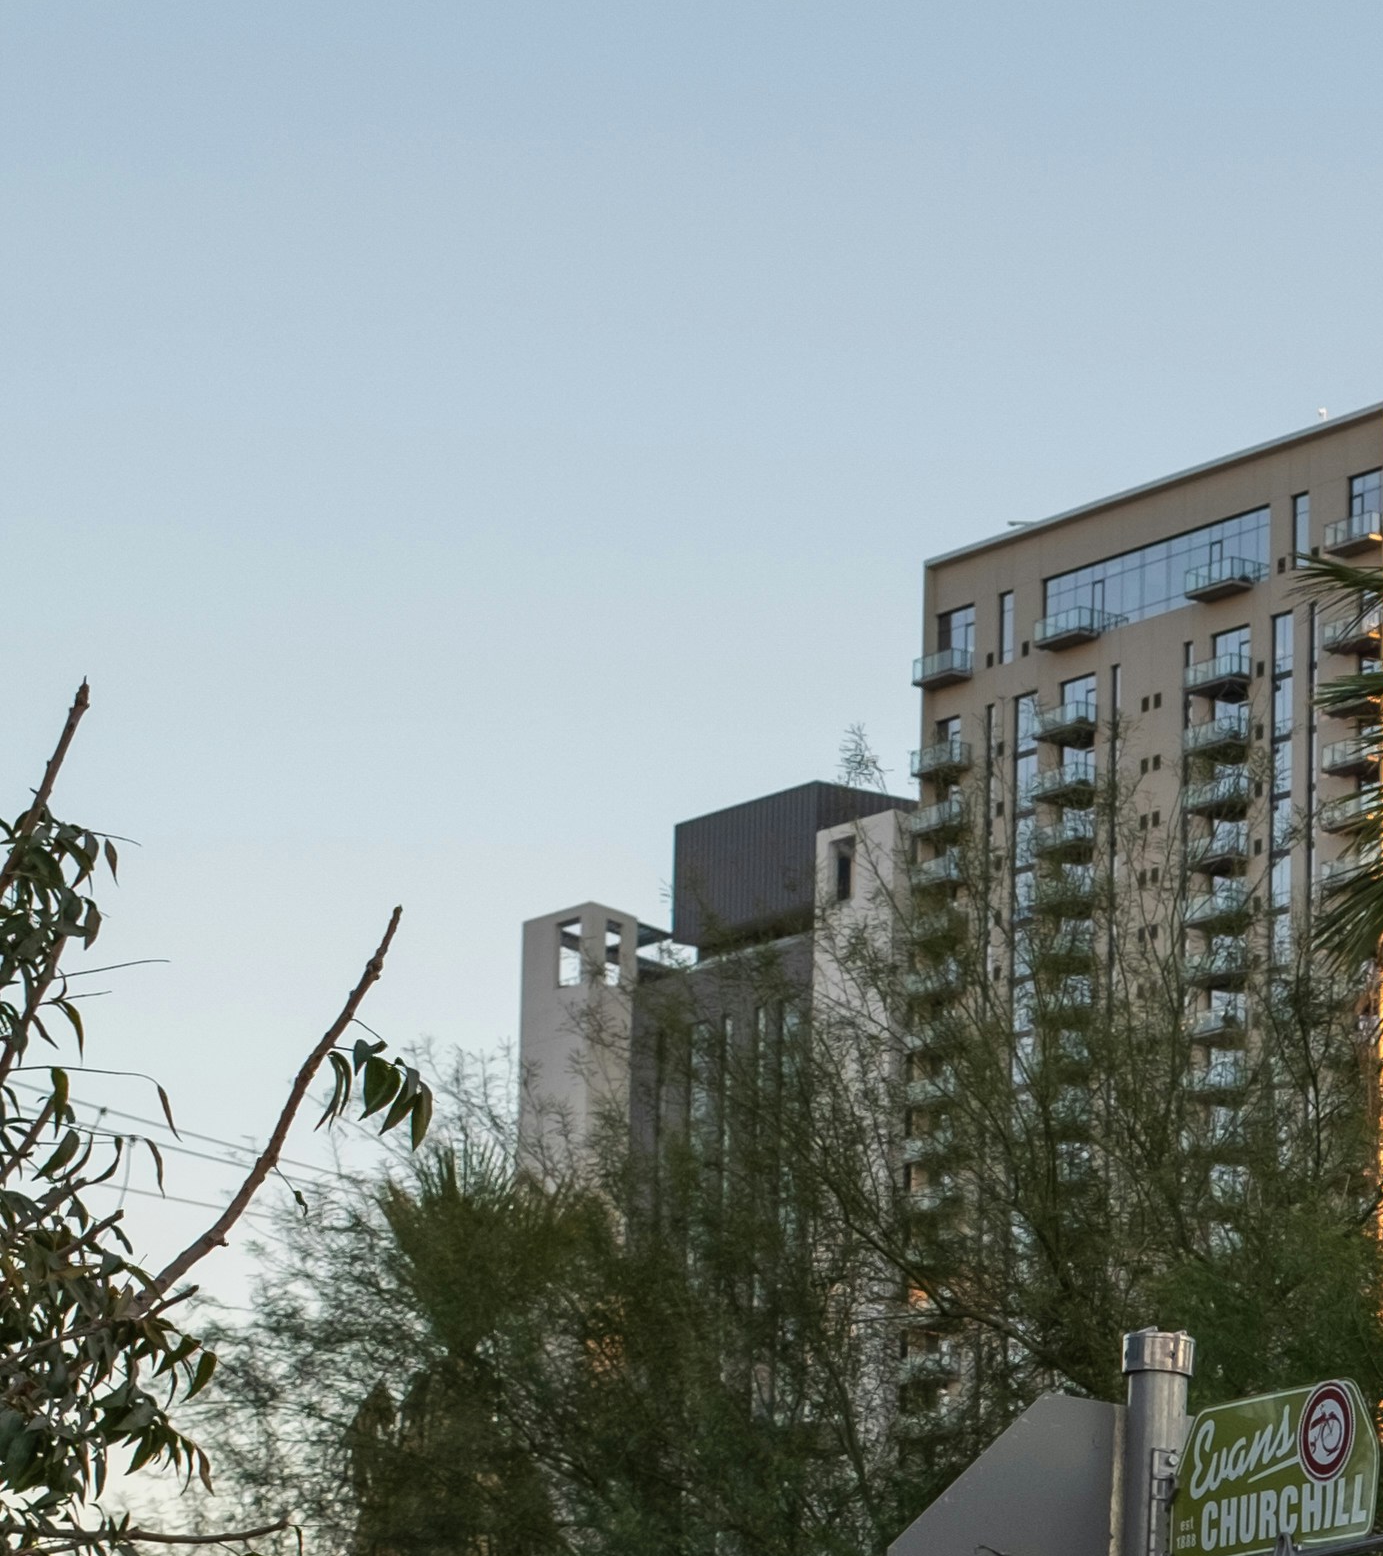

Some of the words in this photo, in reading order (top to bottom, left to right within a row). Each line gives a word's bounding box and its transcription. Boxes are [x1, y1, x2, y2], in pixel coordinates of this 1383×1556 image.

[1190, 1404, 1295, 1499] Evans
[1180, 1516, 1194, 1532] est
[1201, 1473, 1367, 1551] CHURCHILL
[1176, 1533, 1197, 1549] 1888
